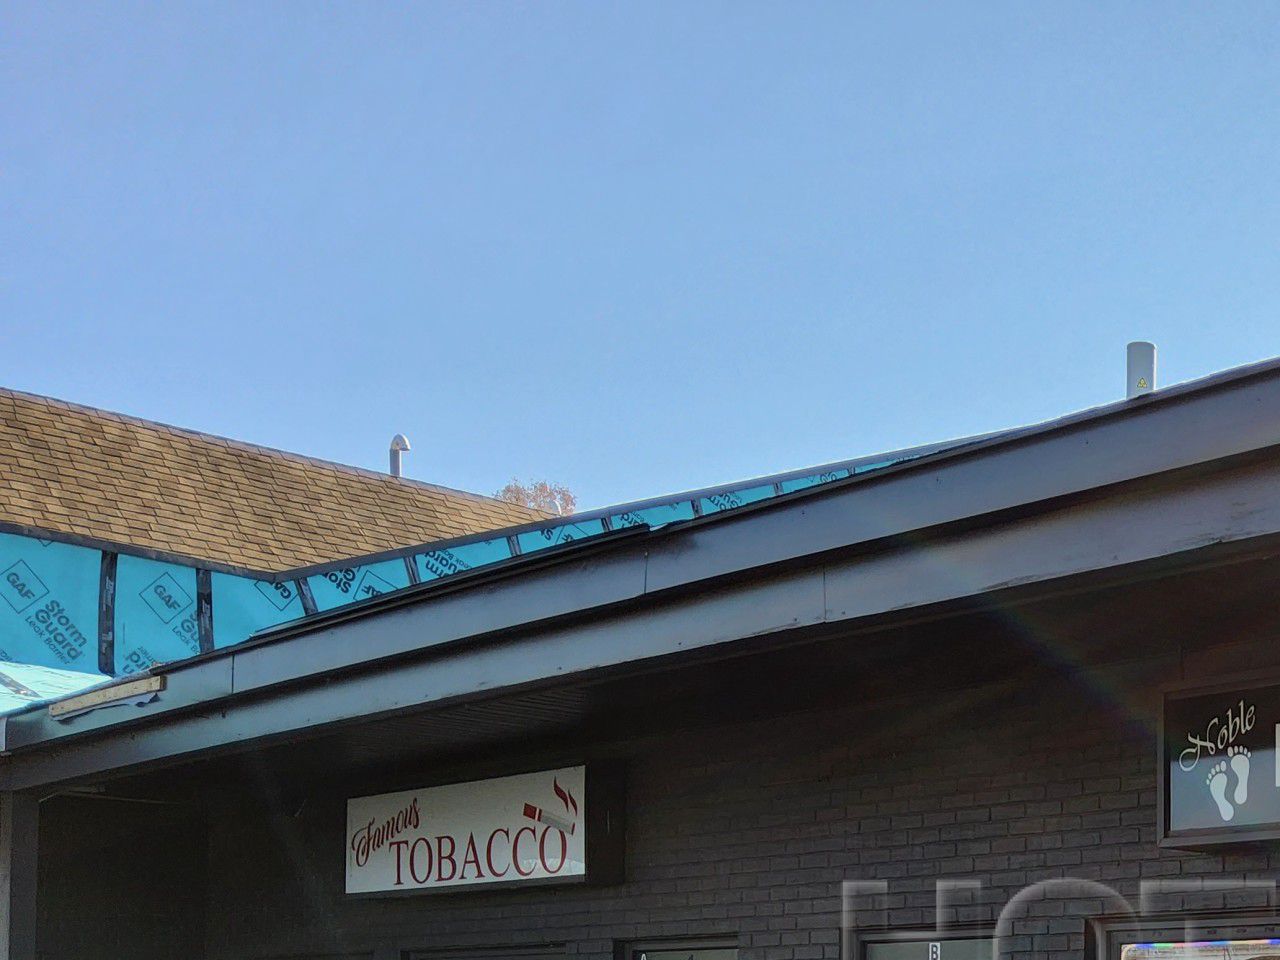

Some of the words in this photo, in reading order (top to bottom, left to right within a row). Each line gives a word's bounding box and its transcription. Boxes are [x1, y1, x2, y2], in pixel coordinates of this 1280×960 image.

[6, 572, 36, 600] GAF
[153, 584, 182, 611] GAF
[271, 581, 292, 600] GA
[25, 615, 47, 643] Leak
[34, 608, 83, 661] Guard
[44, 599, 88, 648] Storm
[1178, 700, 1257, 772] Noble
[351, 797, 420, 868] Famous
[388, 826, 568, 886] TOBACCO
